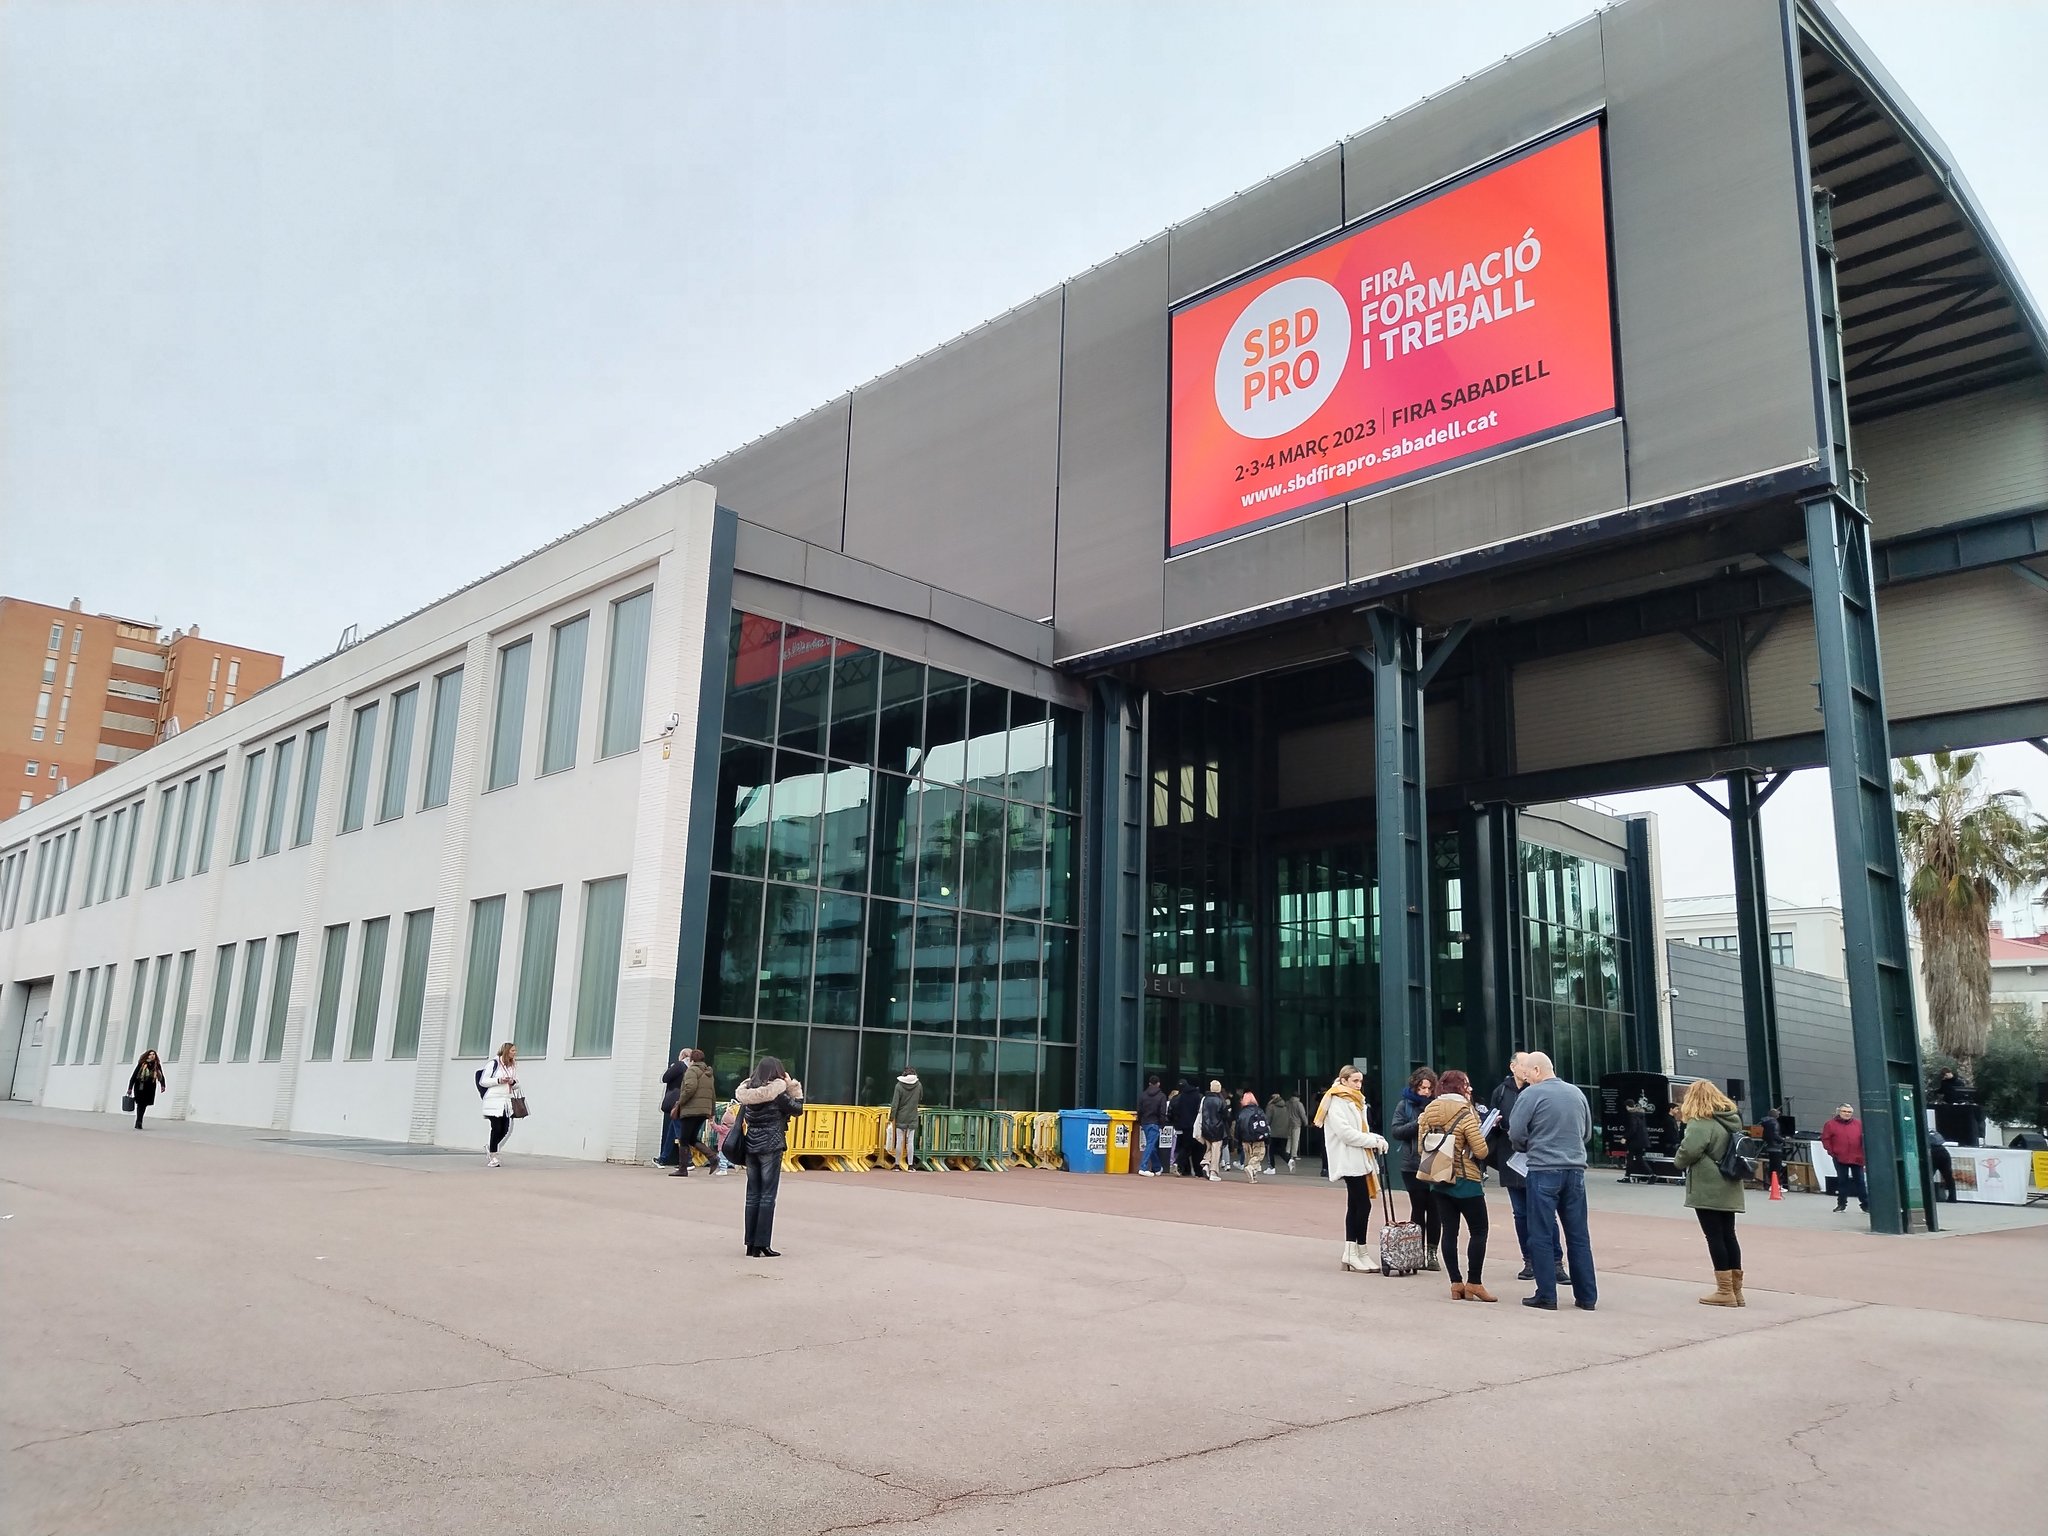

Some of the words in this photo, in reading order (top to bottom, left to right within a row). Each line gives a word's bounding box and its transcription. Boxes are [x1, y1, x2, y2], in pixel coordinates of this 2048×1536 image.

[1360, 260, 1416, 302] FIRA
[1362, 227, 1542, 335] FORMACIÓ
[1362, 338, 1371, 370] I
[1379, 279, 1535, 361] TREBALL
[1243, 307, 1320, 368] SBD
[1243, 349, 1320, 411] PRO
[1240, 410, 1498, 507] www.sbdfirapro.sabadell.cat
[1278, 432, 1330, 467] MARÇ
[1332, 418, 1377, 448] 2023
[1391, 401, 1437, 428] FIRA
[1441, 359, 1551, 412] SABADELL
